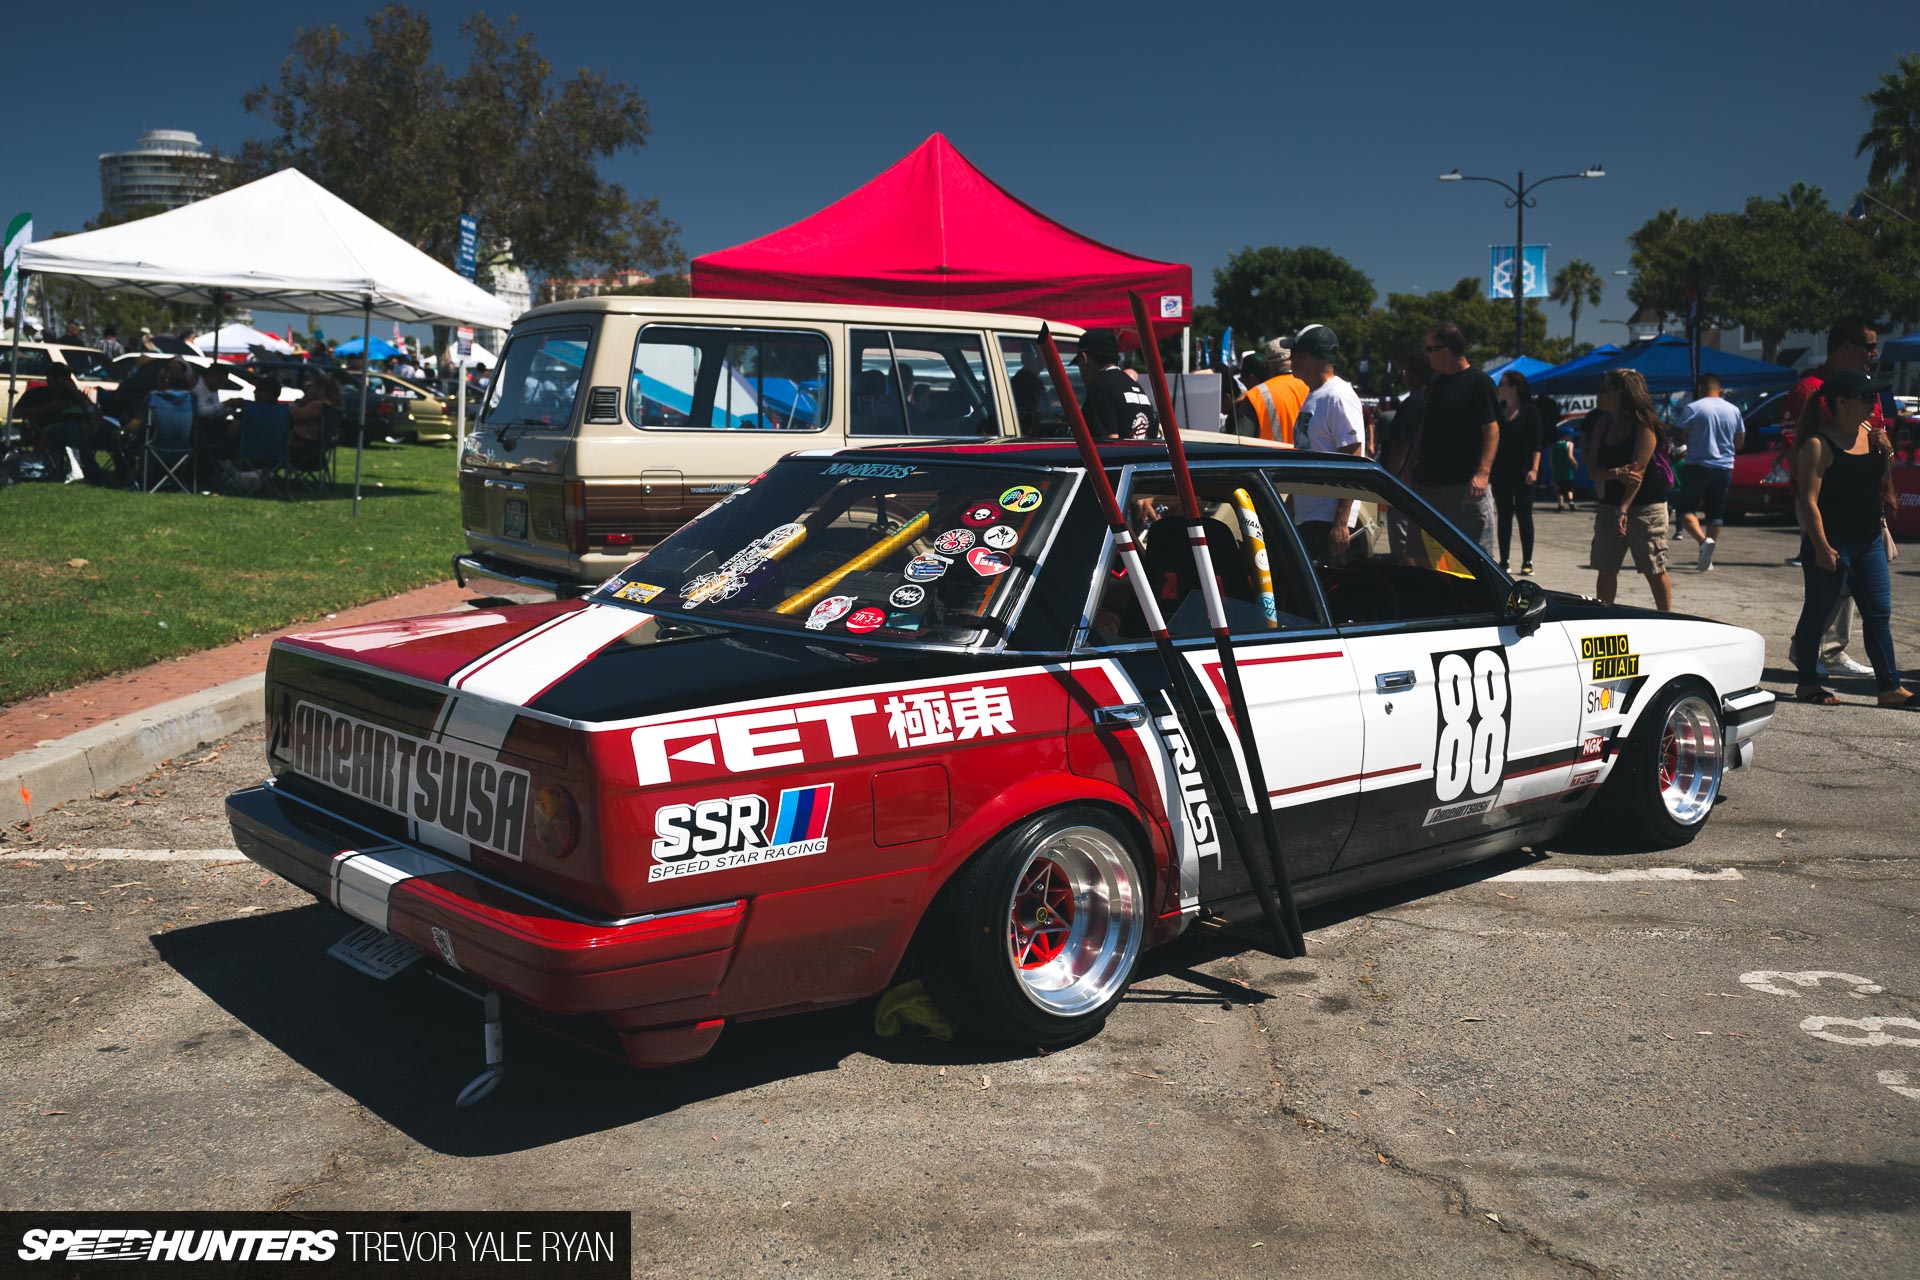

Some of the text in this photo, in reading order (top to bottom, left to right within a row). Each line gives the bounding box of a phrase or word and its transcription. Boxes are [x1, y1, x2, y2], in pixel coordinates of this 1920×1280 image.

[1583, 636, 1627, 657] OLIO
[1594, 657, 1638, 678] FIAT
[630, 699, 877, 787] FET
[884, 686, 1017, 749] 極東
[1434, 649, 1508, 802] 88
[1582, 738, 1603, 755] NGK
[652, 794, 769, 864] SSR
[650, 840, 827, 880] SPEED STAR RACING
